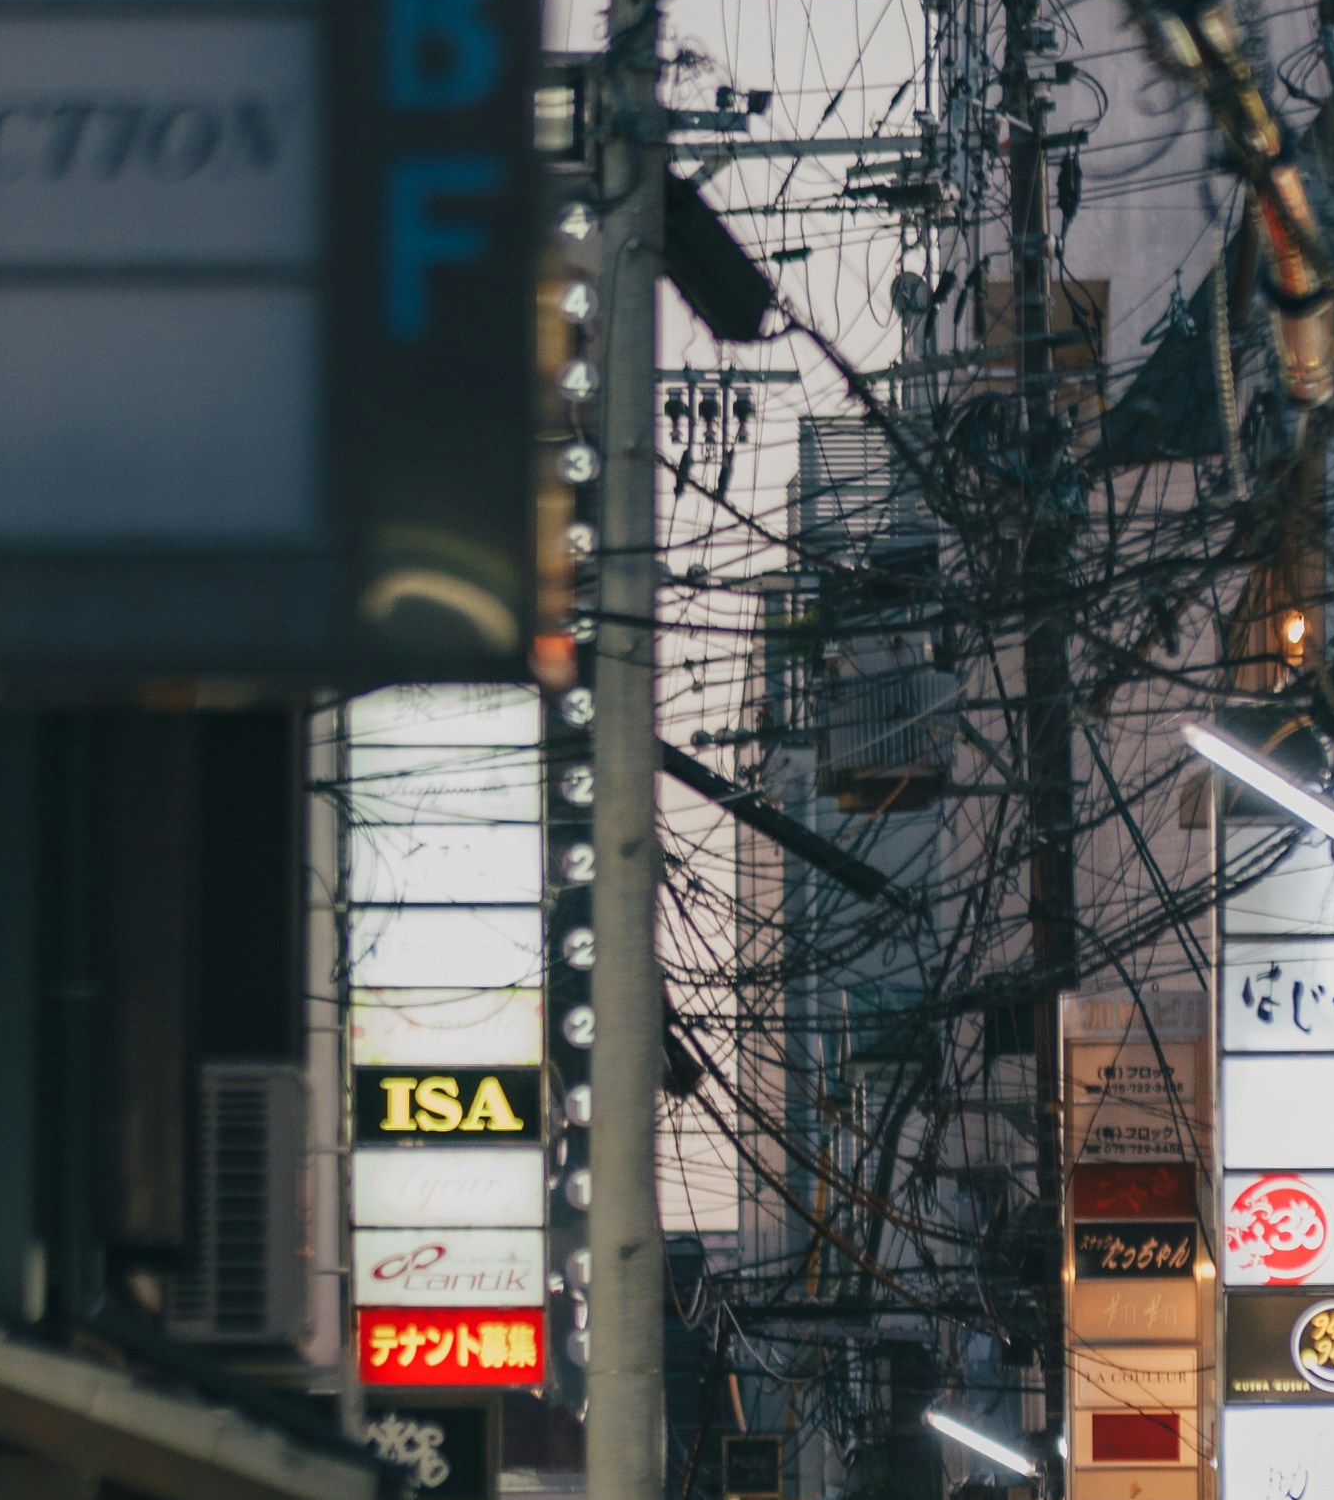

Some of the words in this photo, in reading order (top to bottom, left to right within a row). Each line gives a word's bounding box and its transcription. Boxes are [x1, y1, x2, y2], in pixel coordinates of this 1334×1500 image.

[379, 1076, 524, 1132] ISA
[369, 1323, 537, 1368] テナント募集
